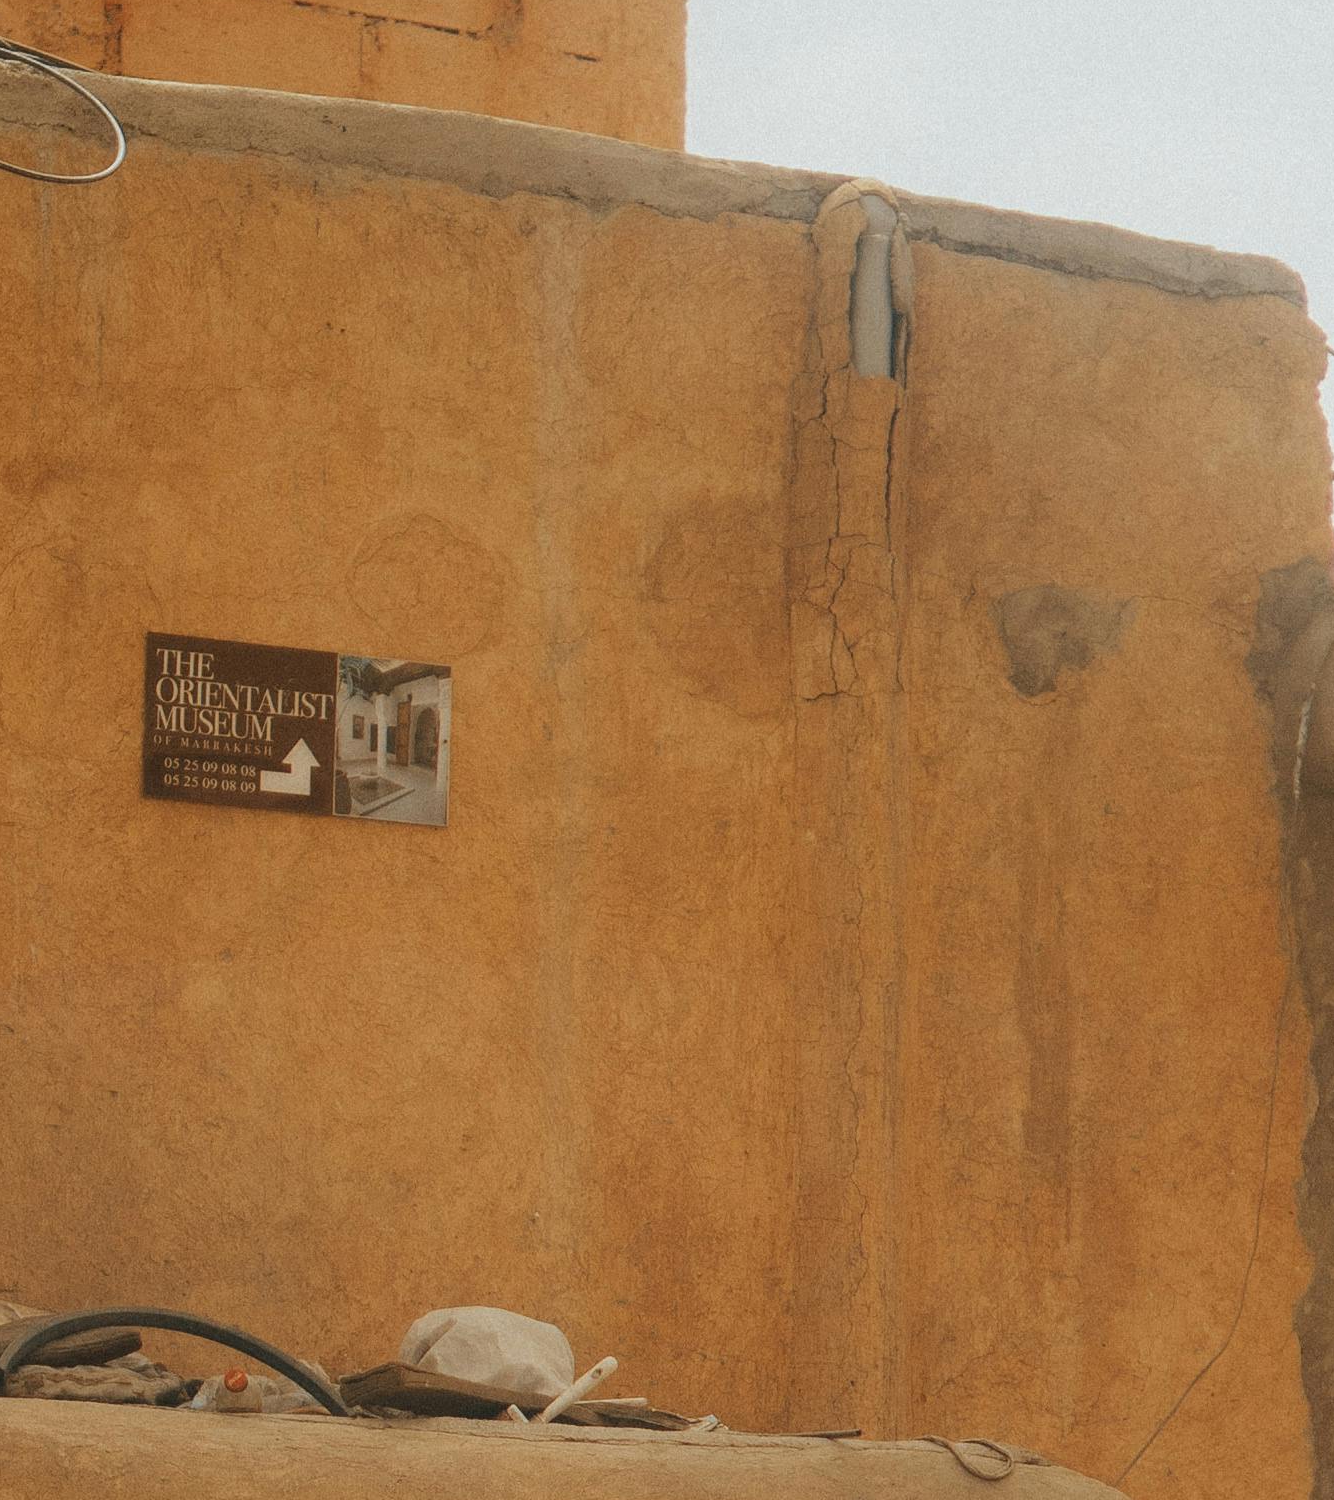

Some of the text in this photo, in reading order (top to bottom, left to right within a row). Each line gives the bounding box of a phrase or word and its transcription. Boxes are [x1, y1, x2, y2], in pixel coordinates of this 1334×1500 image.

[156, 648, 215, 680] THE
[155, 676, 334, 721] ORIENTALIST
[155, 704, 274, 743] MUSEUM
[153, 734, 273, 757] OF MARRAKESH
[163, 756, 256, 778] 05 25 09 08 08
[163, 773, 257, 794] 05 25 09 08 09
